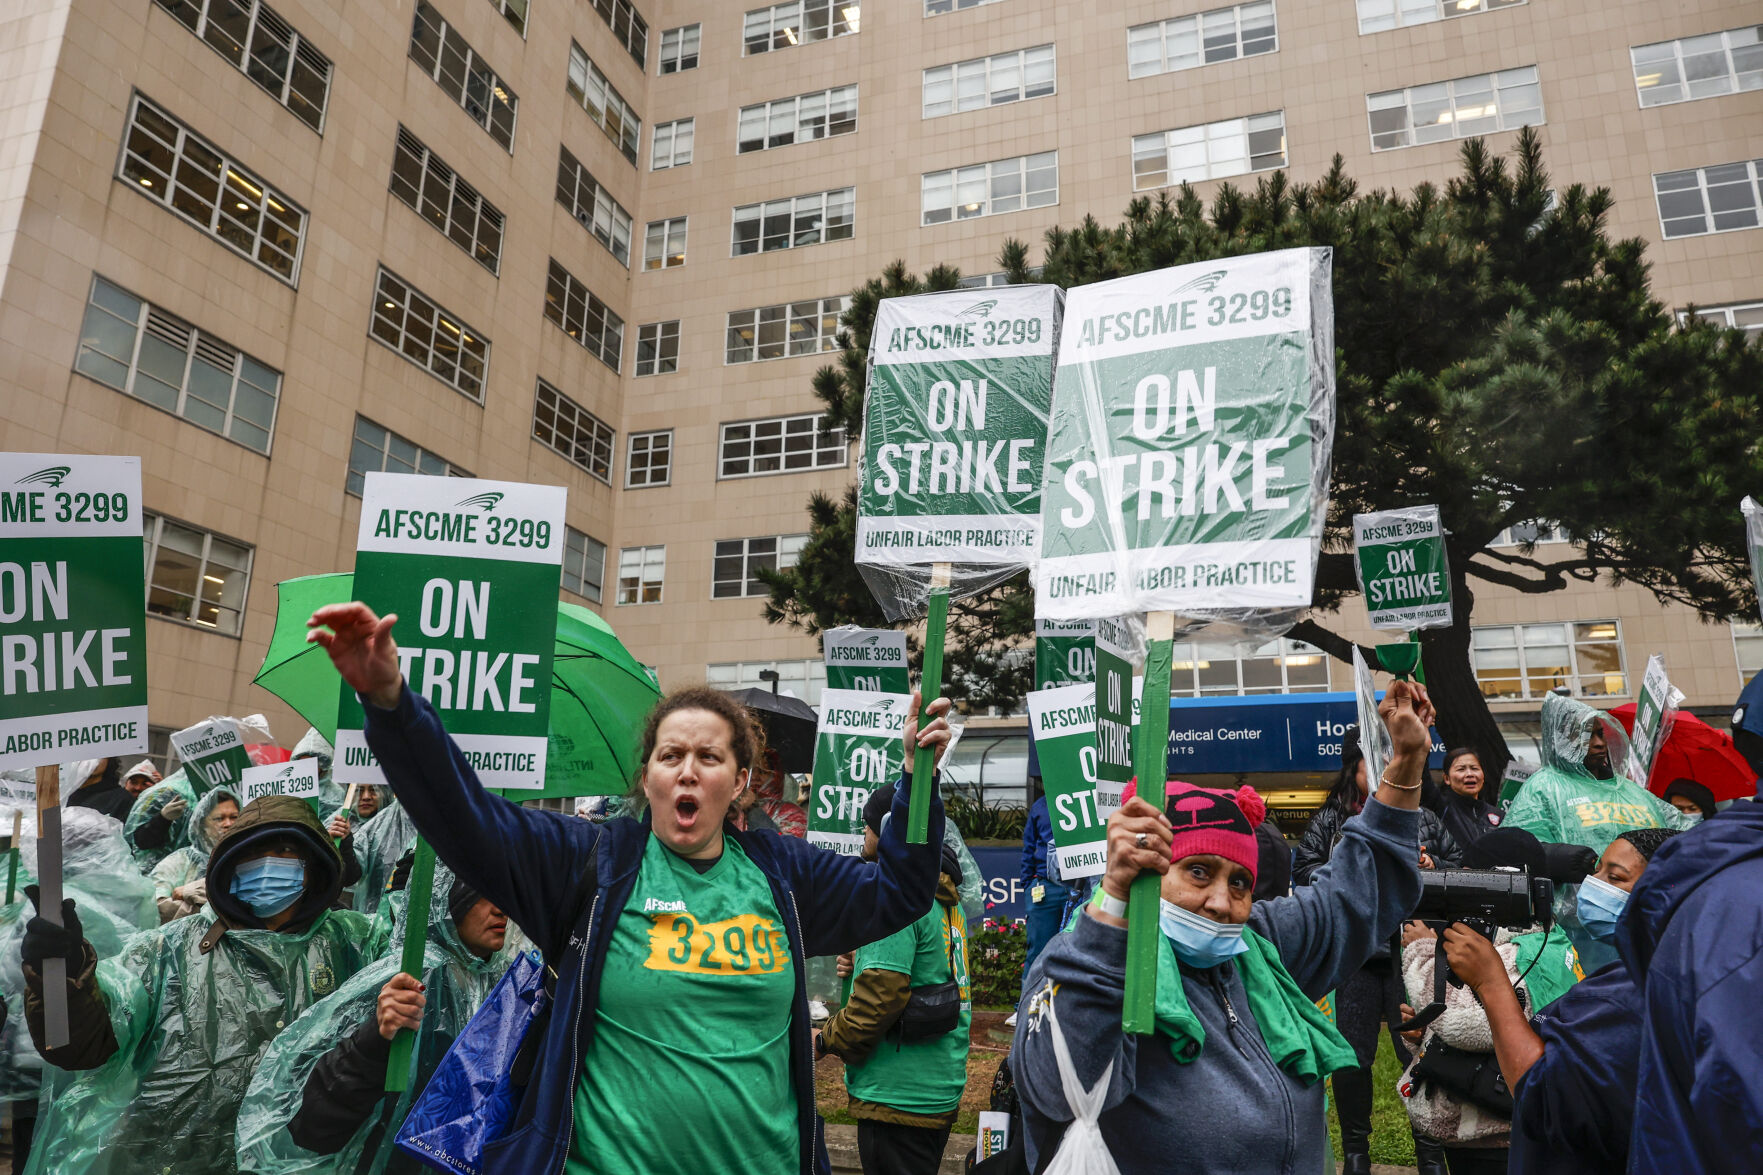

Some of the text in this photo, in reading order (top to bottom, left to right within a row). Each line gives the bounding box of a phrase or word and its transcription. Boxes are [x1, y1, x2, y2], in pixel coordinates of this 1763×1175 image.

[1077, 287, 1292, 348] AFSCME 3299
[887, 317, 1042, 353] AFSCME 3299
[928, 378, 988, 432] ON
[1133, 366, 1217, 440] ON
[874, 438, 1035, 496] STRIKE
[1060, 437, 1290, 529] STRIKE
[55, 492, 128, 522] 3299
[374, 509, 551, 549] AFSCME 3299
[866, 529, 1034, 548] UNFAIR LABOR PRACTICE
[1362, 521, 1433, 541] AFSCME 3299
[1387, 548, 1416, 574] ON
[0, 561, 69, 624] ON
[1049, 560, 1296, 599] UNFAIR ABOR PRACTICE
[1369, 571, 1442, 603] STRIKE
[419, 577, 491, 640] ON
[1373, 615, 1395, 624] UNFAIR
[1417, 608, 1447, 619] PRACTICE
[2, 628, 132, 695] RIKE
[831, 646, 901, 661] AFSCME 3299
[355, 647, 540, 713] TRIKE
[1108, 670, 1121, 715] ON
[826, 708, 882, 729] AFSCME
[1168, 728, 1262, 742] Medical Center
[0, 721, 138, 755] ABOR PRACTICE
[180, 730, 237, 756] AFSCME 3299
[1098, 717, 1132, 768] STRIKE
[1318, 743, 1342, 755] 505
[206, 759, 232, 785] ON
[850, 747, 888, 783] ON
[248, 780, 286, 800] AFSCME
[288, 776, 314, 793] 3299
[817, 784, 875, 821] STR
[1268, 809, 1310, 819] Avenue
[843, 843, 865, 855] LABO
[1064, 852, 1099, 869] UNFAIR
[643, 897, 688, 912] AFSCME
[981, 877, 1025, 904] SF
[667, 916, 776, 971] 3299
